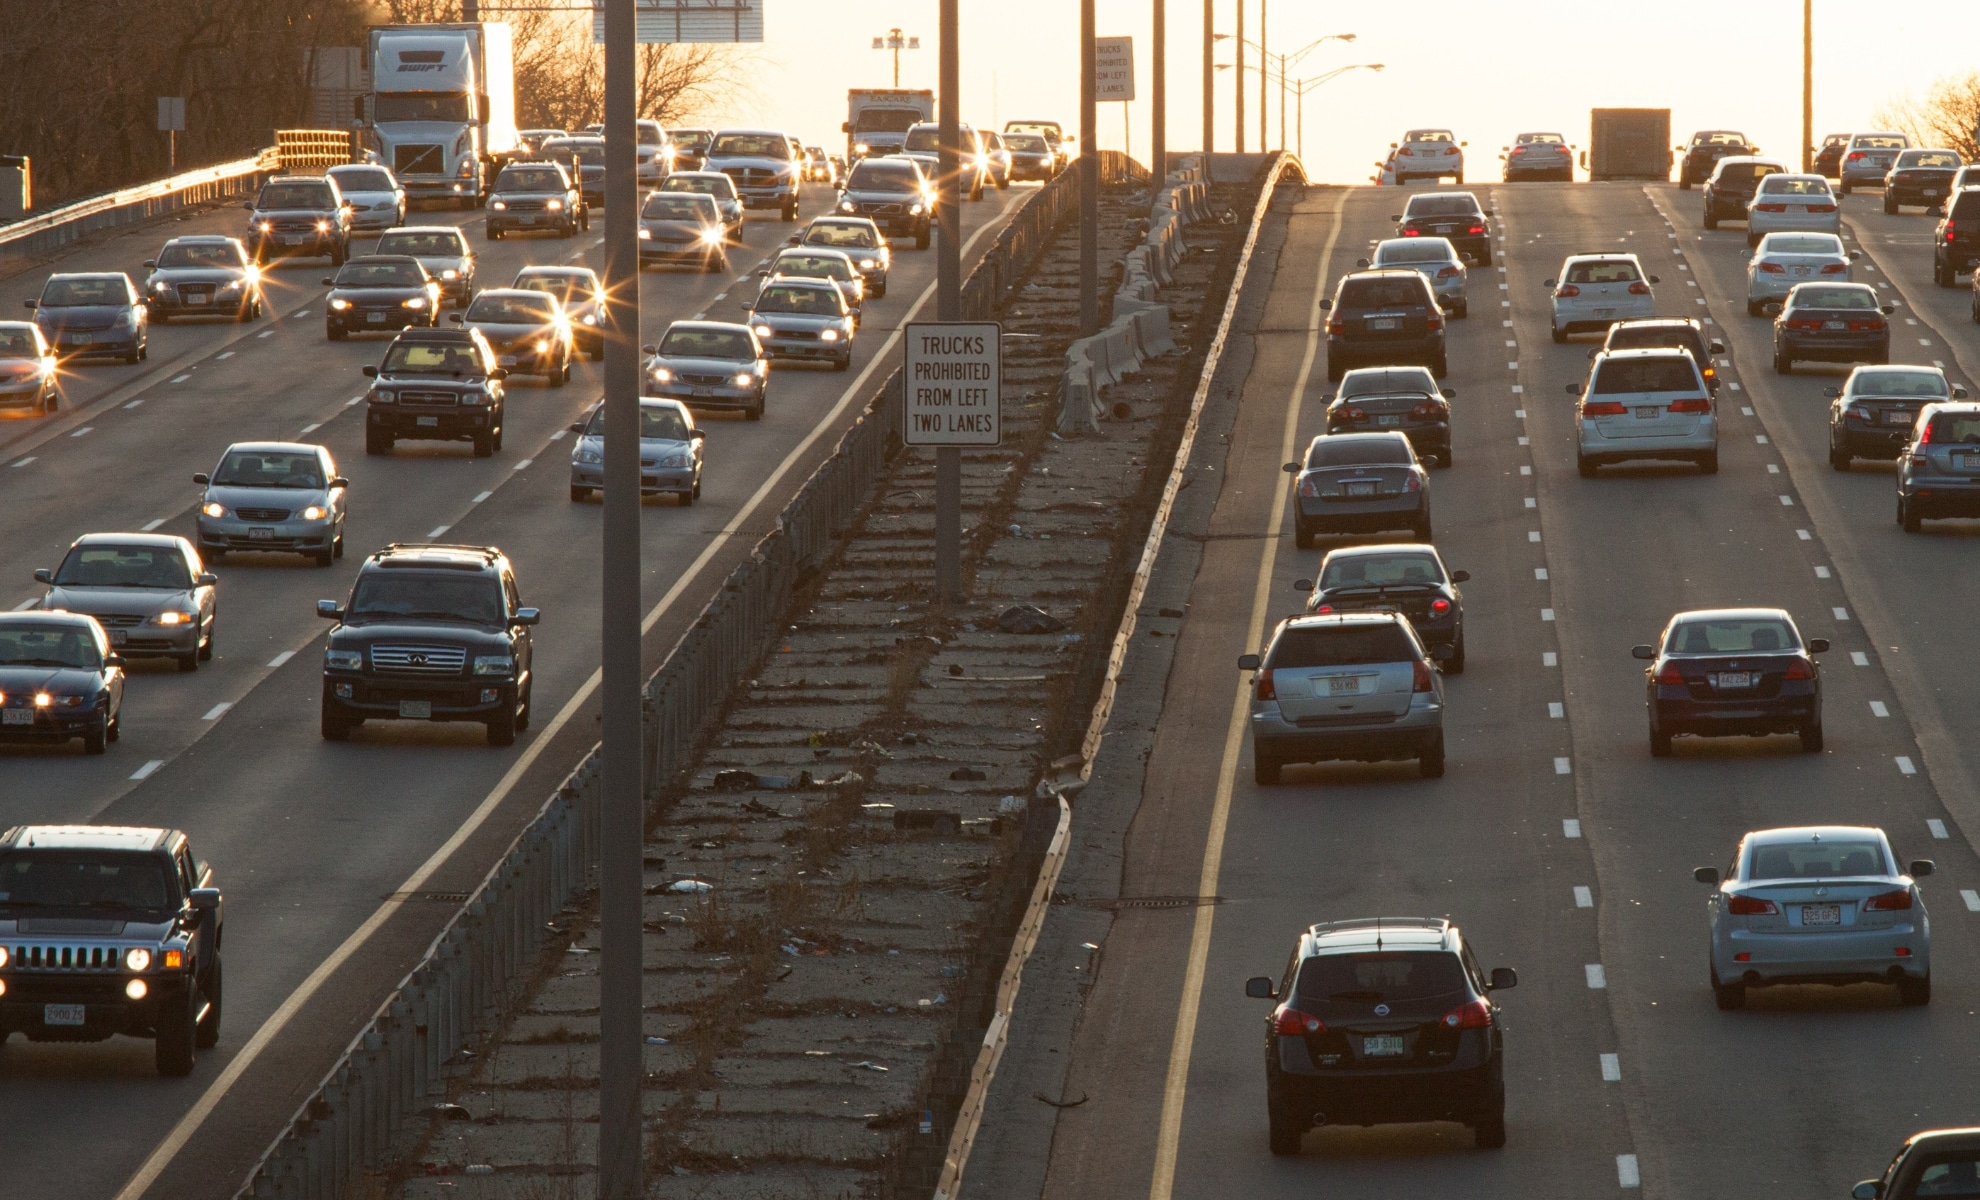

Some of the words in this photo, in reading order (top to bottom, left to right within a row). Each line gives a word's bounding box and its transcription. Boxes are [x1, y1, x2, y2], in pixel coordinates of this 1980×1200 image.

[396, 64, 448, 72] SWIFT
[1096, 58, 1128, 67] OHIBITED
[1111, 71, 1126, 80] LEFT
[1103, 84, 1125, 93] LANES
[921, 336, 984, 355] TRUCKS
[915, 362, 990, 380] PROHIBITED
[917, 388, 952, 406] FROM
[958, 388, 988, 406] LEFT
[913, 414, 941, 432] TWO
[949, 414, 992, 432] LANES
